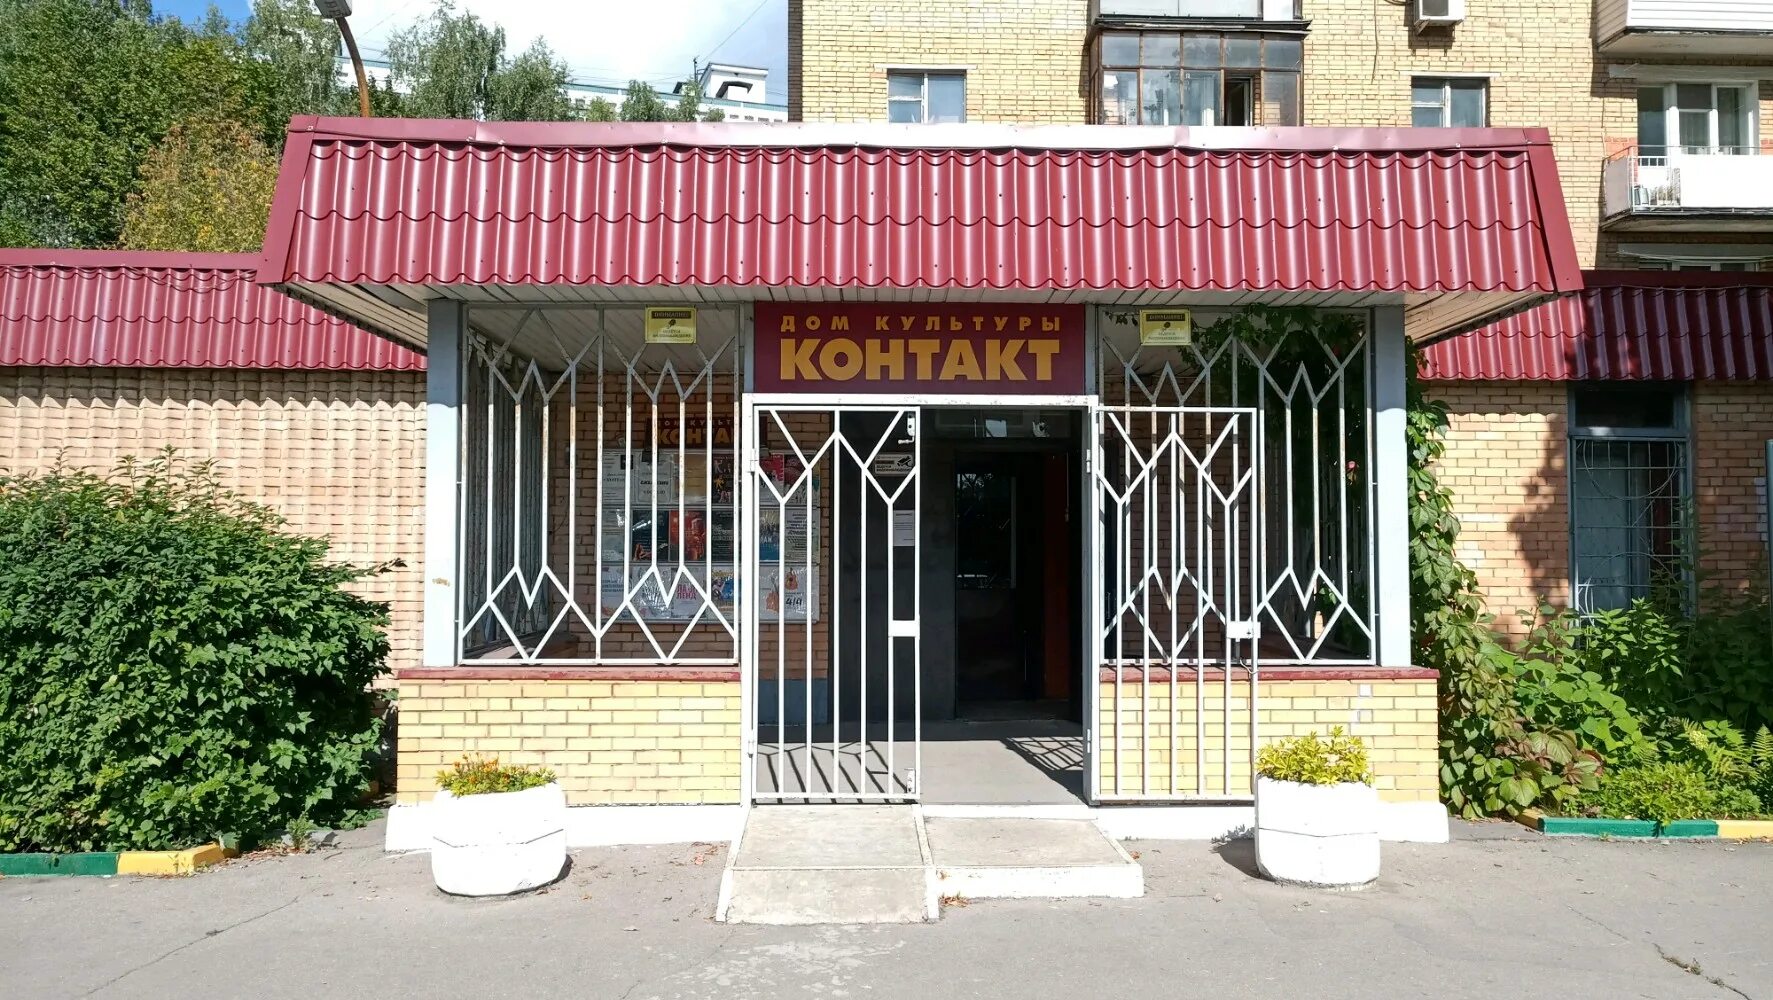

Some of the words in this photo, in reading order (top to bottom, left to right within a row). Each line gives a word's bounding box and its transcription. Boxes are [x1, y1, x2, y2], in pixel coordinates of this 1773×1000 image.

[780, 315, 849, 332] ДОМ
[875, 315, 1060, 332] КУЛЬТУРЫ
[780, 338, 1060, 381] КОНТАКТ
